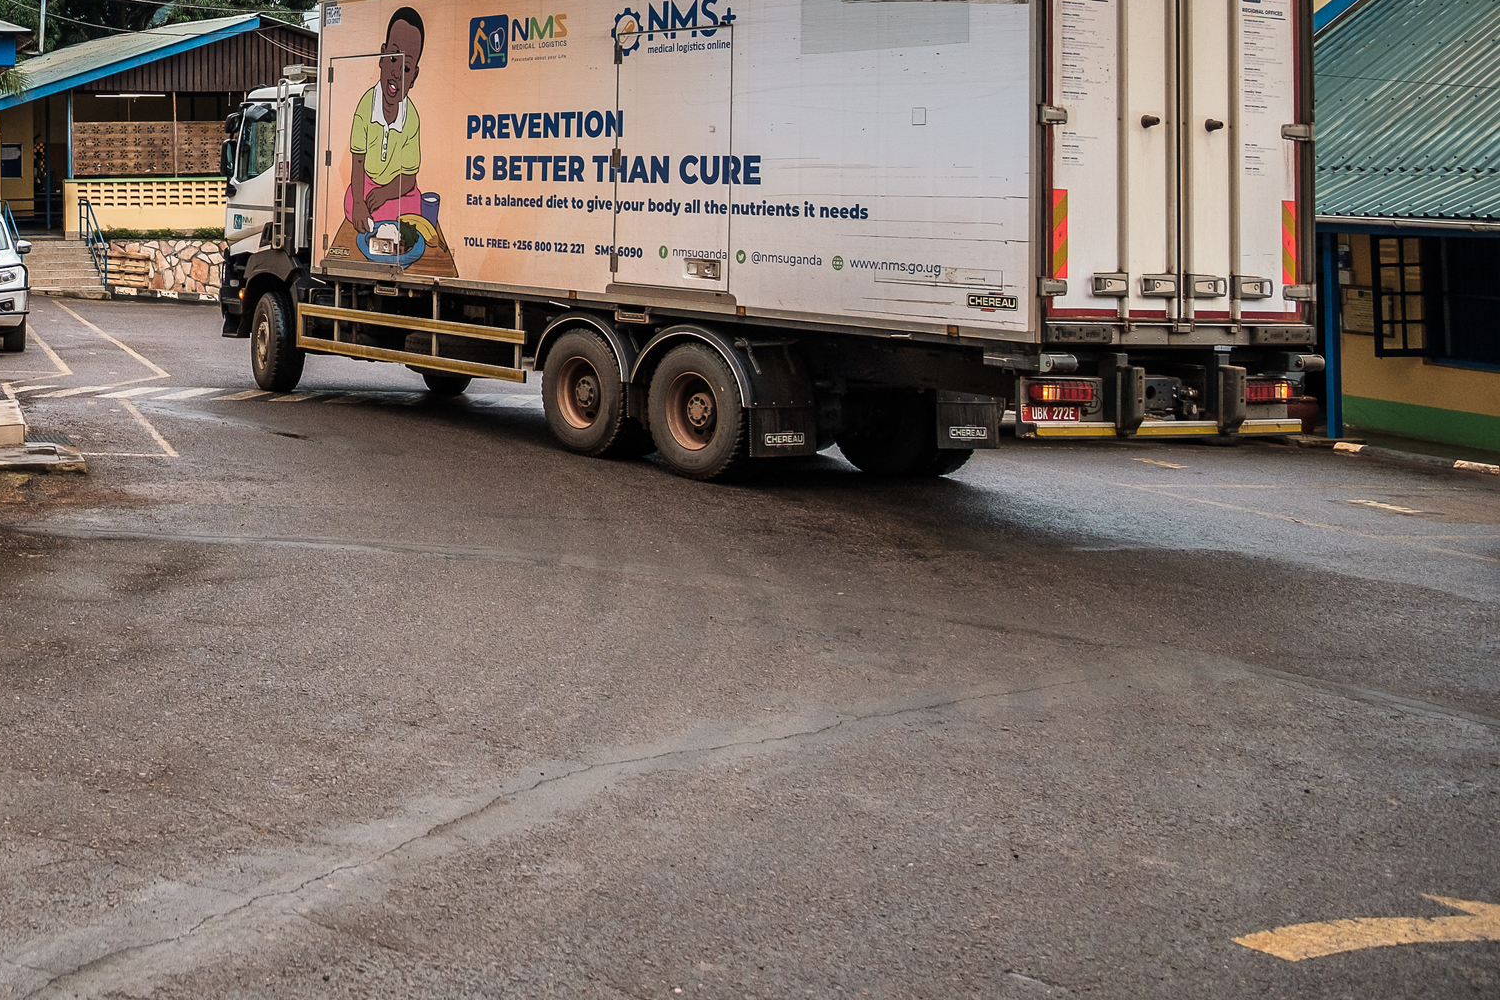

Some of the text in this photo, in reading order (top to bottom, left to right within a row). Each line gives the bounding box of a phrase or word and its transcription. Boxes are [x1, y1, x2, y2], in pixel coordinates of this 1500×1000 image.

[1242, 7, 1283, 17] REGIONAL OFFICES
[511, 13, 568, 42] NMS
[511, 40, 567, 50] MEDICAL LOGISTICS
[647, 40, 731, 54] medical logistics online
[466, 110, 624, 140] PREVENTION
[465, 154, 762, 185] IS BETTER THAN CURE
[466, 194, 869, 220] Eat a balanced diet to give your body all the nutrients it needs
[330, 248, 350, 256] CHEREAU
[463, 237, 643, 259] TOLL FREE: +256 800 122 221 SMS 6090
[672, 247, 942, 276] nmsuganda @nmsuganda www.nms.go.ug
[968, 296, 1016, 309] CHEREAU
[1032, 406, 1048, 420] UBK
[1052, 406, 1076, 420] 272E
[766, 435, 803, 443] CHEREAU
[951, 428, 986, 438] CHEREAU
